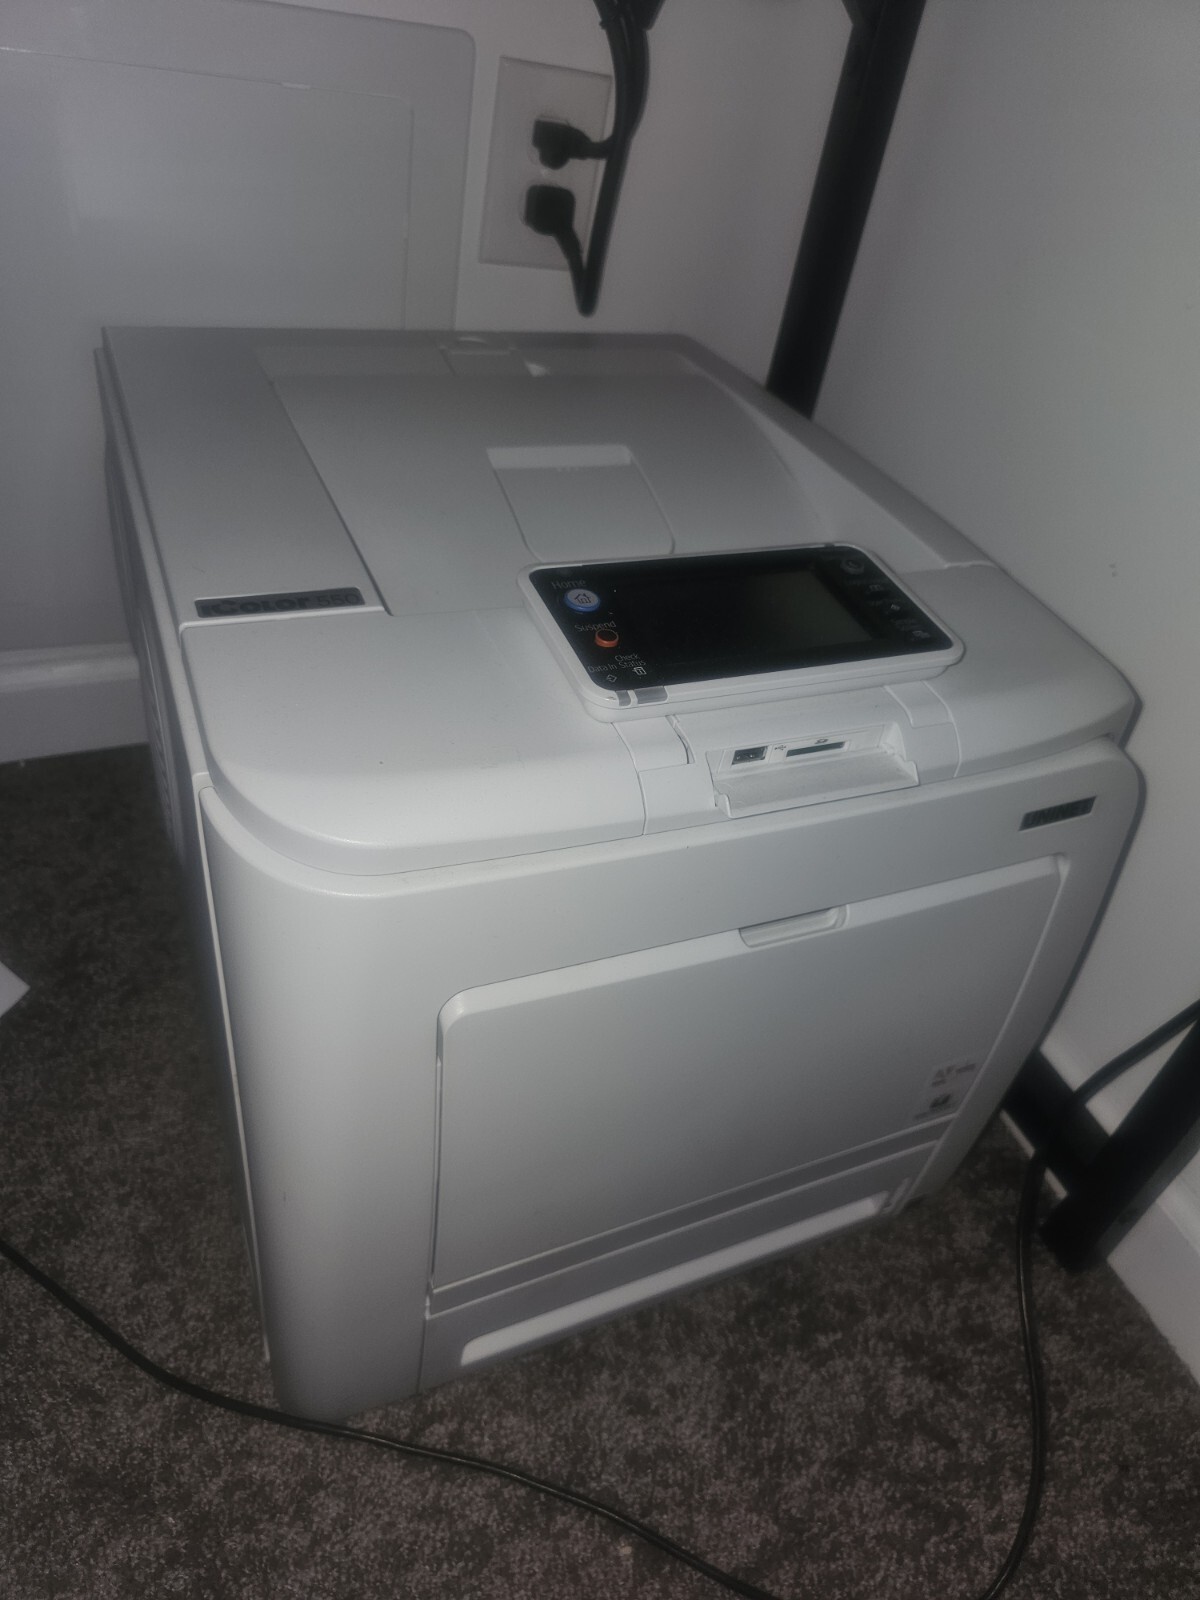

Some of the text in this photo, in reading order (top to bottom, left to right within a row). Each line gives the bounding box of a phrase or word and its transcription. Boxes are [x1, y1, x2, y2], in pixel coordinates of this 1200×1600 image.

[551, 578, 587, 590] Home
[316, 593, 360, 607] 550
[574, 620, 617, 632] Suspend
[614, 652, 640, 662] Check
[587, 663, 618, 673] Data In
[618, 660, 647, 669] Status
